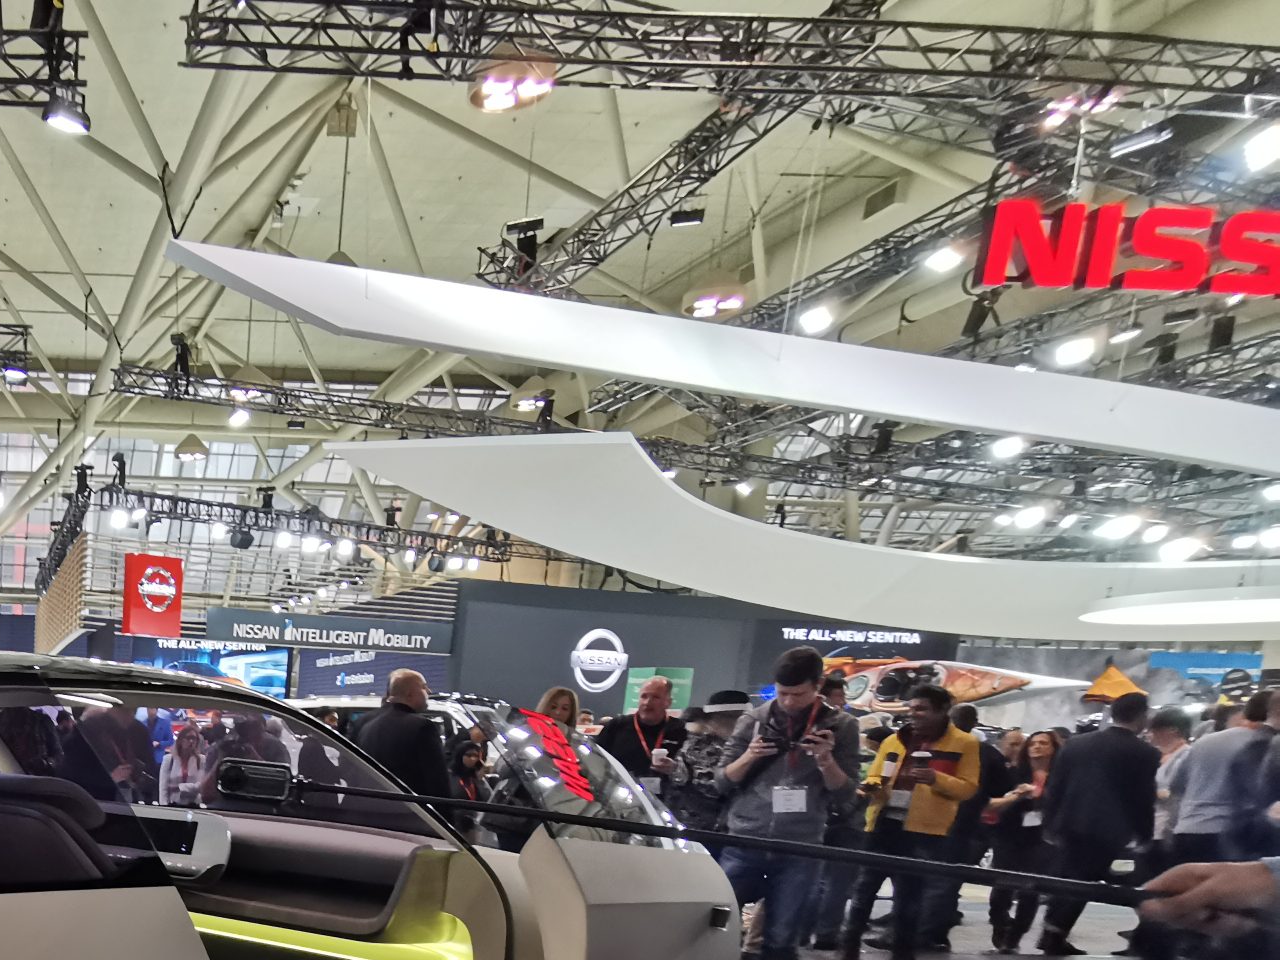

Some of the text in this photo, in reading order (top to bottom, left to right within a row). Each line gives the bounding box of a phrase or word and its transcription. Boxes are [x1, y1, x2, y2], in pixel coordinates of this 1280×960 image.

[232, 618, 432, 649] NISSAN INTELLIGENT MOBILITY
[781, 627, 921, 644] THE ALL-NEW SENTRA
[156, 639, 267, 652] THE ALL-NEW SENTRA
[576, 655, 623, 667] NISSAN
